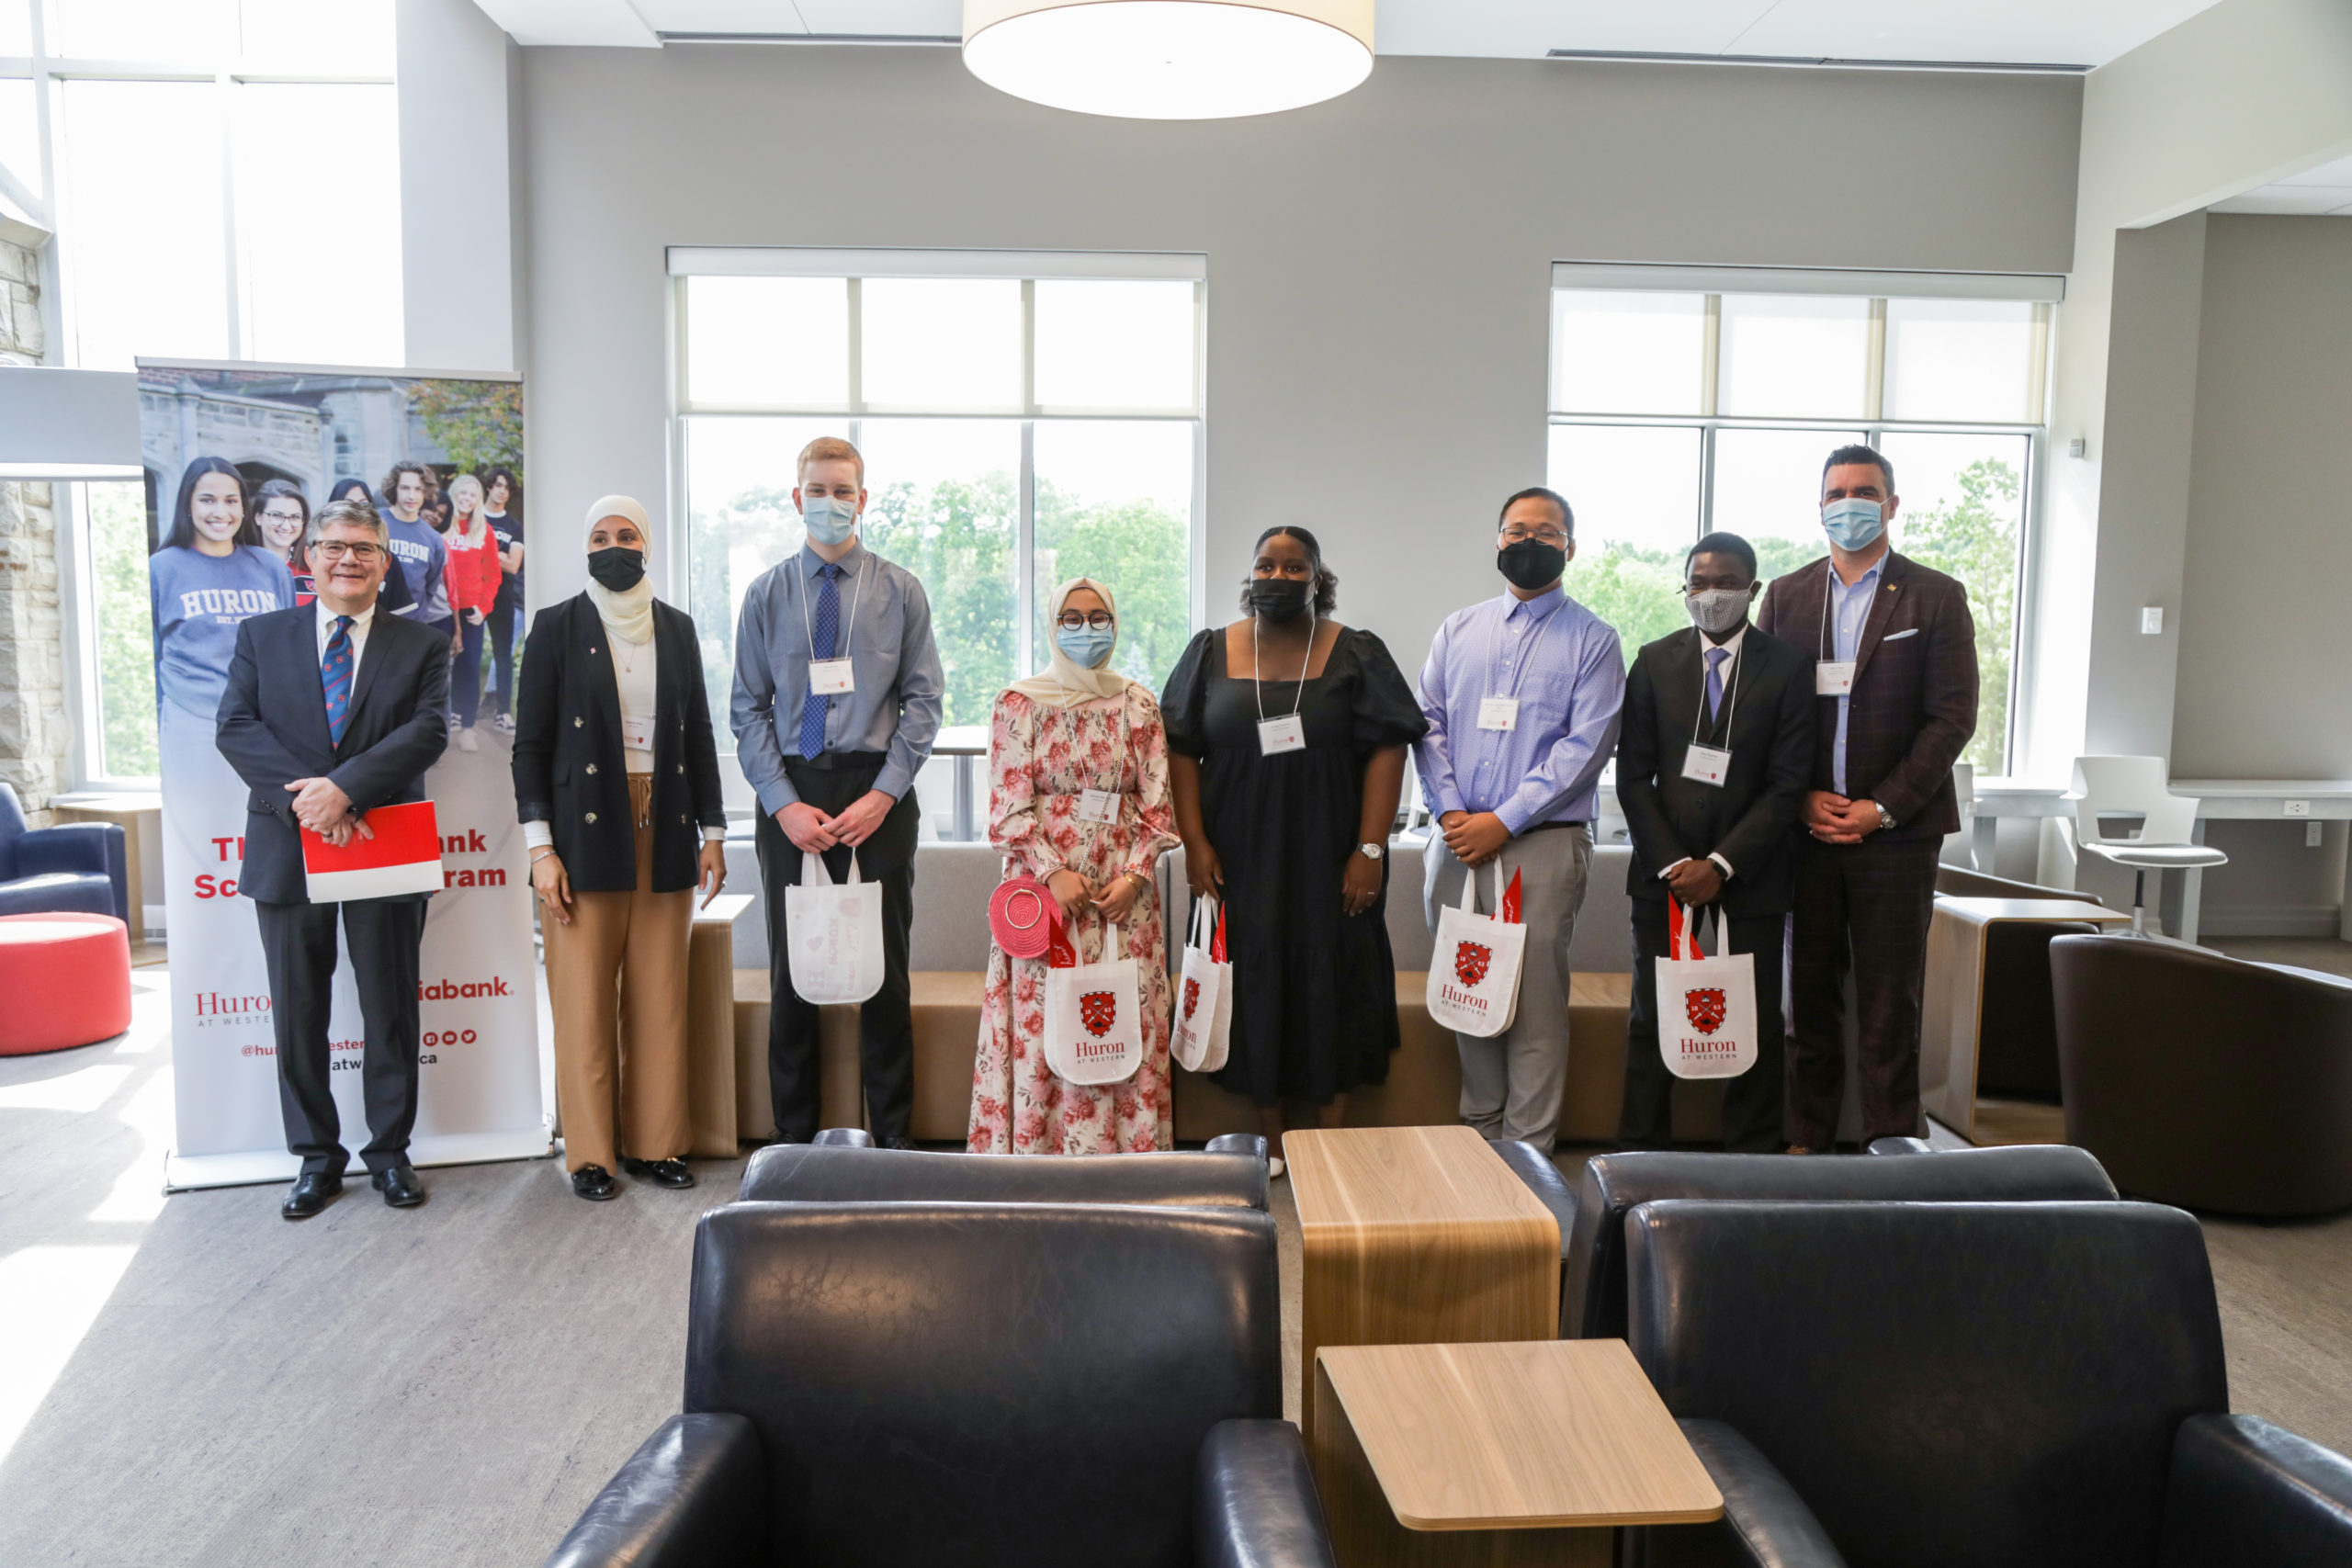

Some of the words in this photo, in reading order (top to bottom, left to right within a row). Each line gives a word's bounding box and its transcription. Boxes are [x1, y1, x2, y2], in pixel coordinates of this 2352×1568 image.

[389, 538, 430, 563] URON
[179, 589, 277, 620] HURON
[195, 991, 272, 1017] Huro
[1442, 984, 1488, 1010] Huron
[198, 1019, 214, 1028] AT
[222, 1015, 270, 1026] WESTE
[1075, 1042, 1125, 1058] Huron
[1680, 1038, 1736, 1054] Huron
